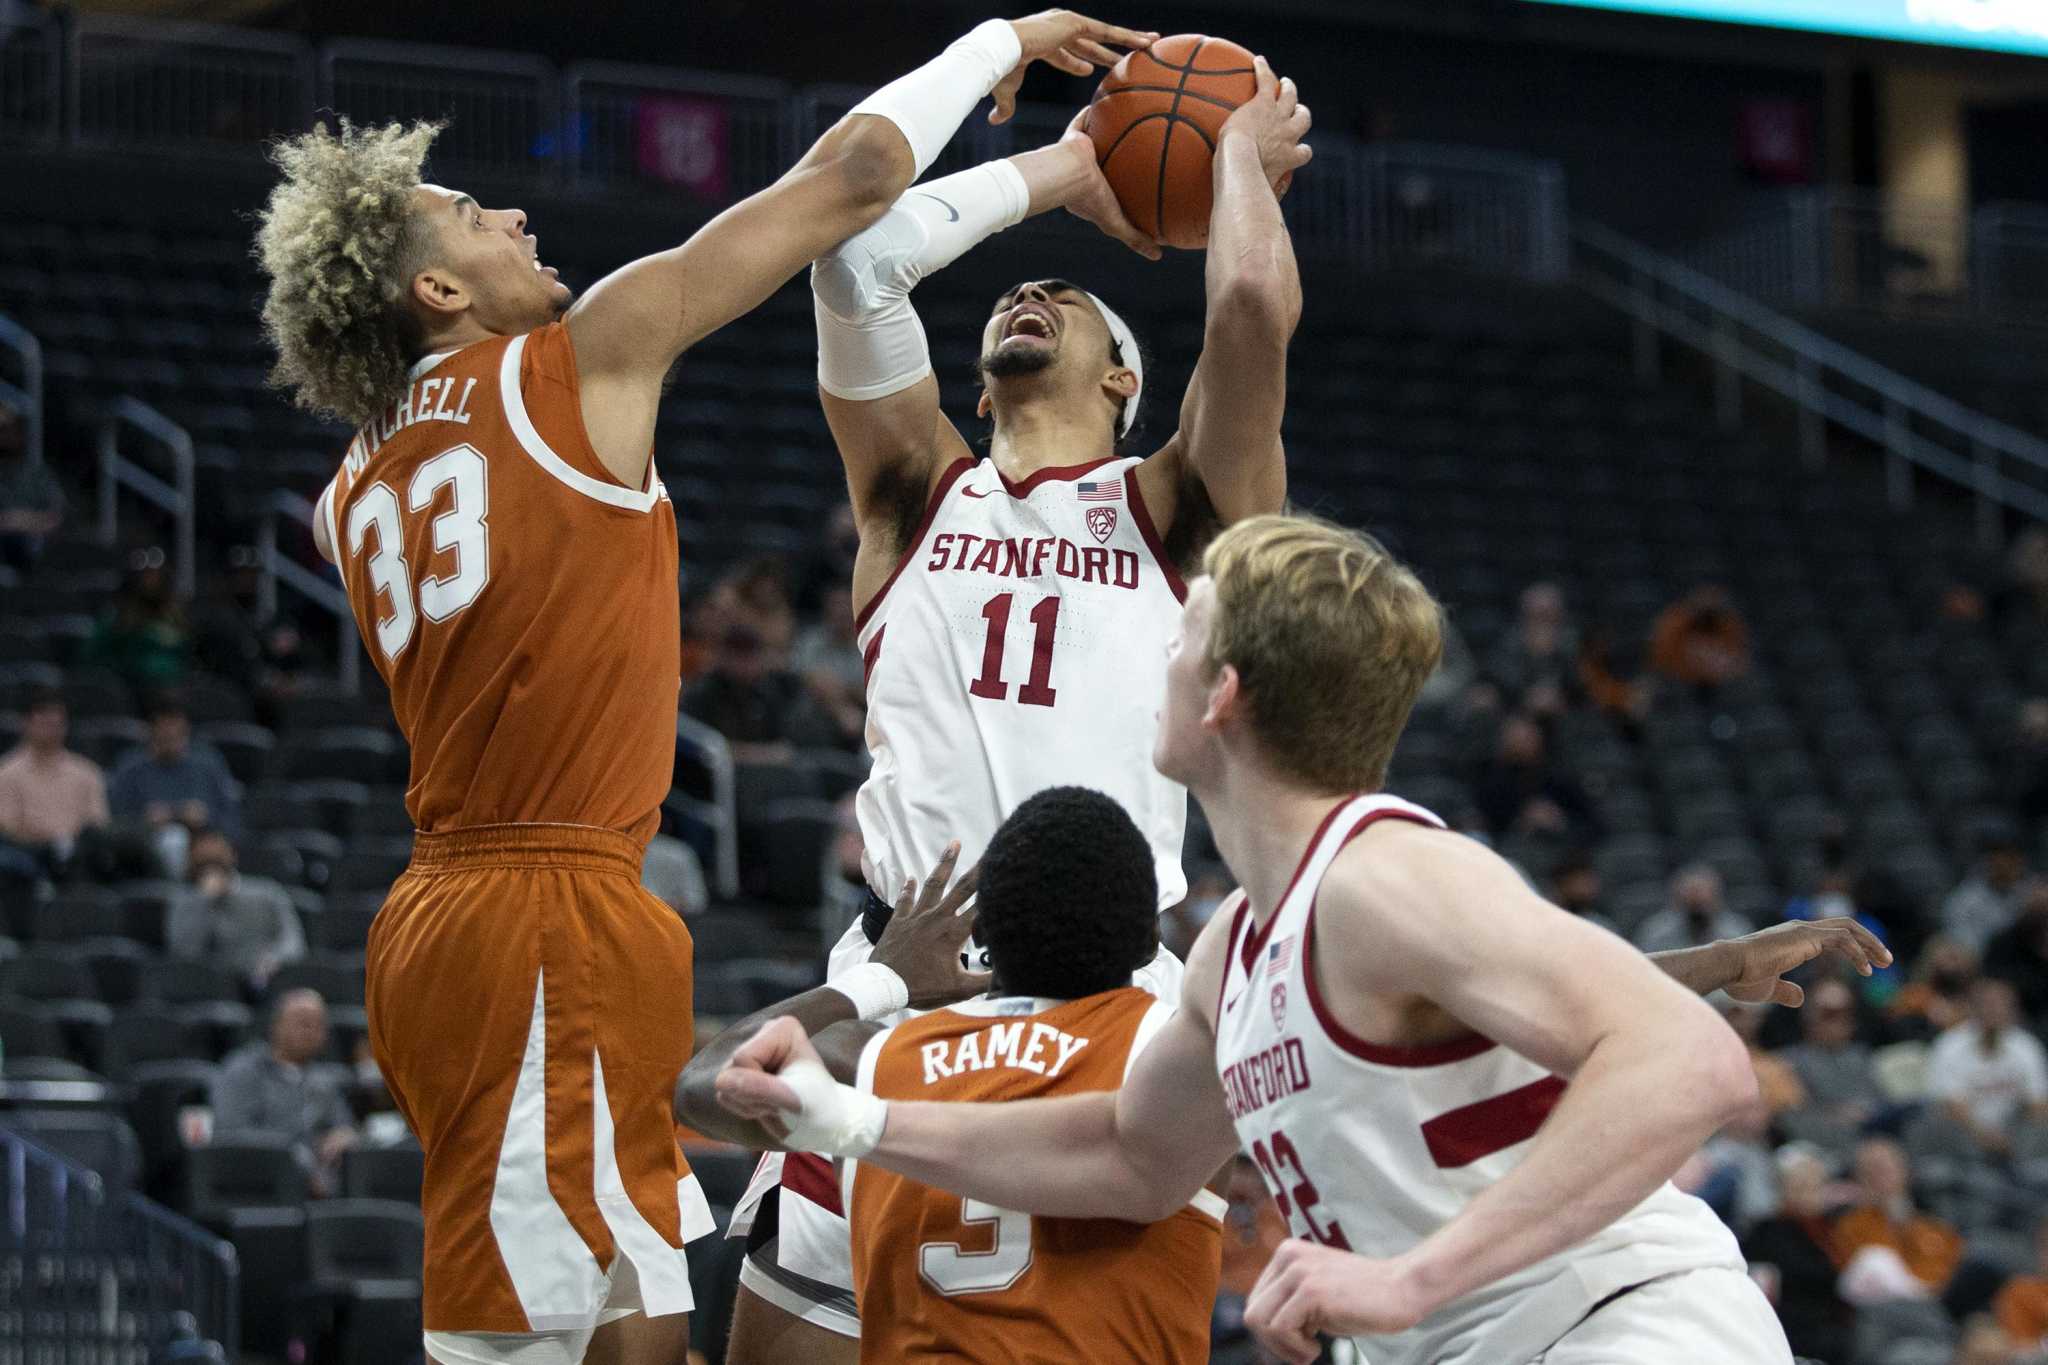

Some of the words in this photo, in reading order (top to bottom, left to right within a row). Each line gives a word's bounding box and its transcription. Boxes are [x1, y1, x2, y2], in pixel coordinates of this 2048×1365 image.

[349, 443, 490, 664] 33
[928, 533, 1139, 590] STANFORD
[1094, 522, 1109, 535] 12
[969, 592, 1061, 708] 11
[921, 1021, 1090, 1086] RAMEY
[1221, 1036, 1311, 1120] TANFORD
